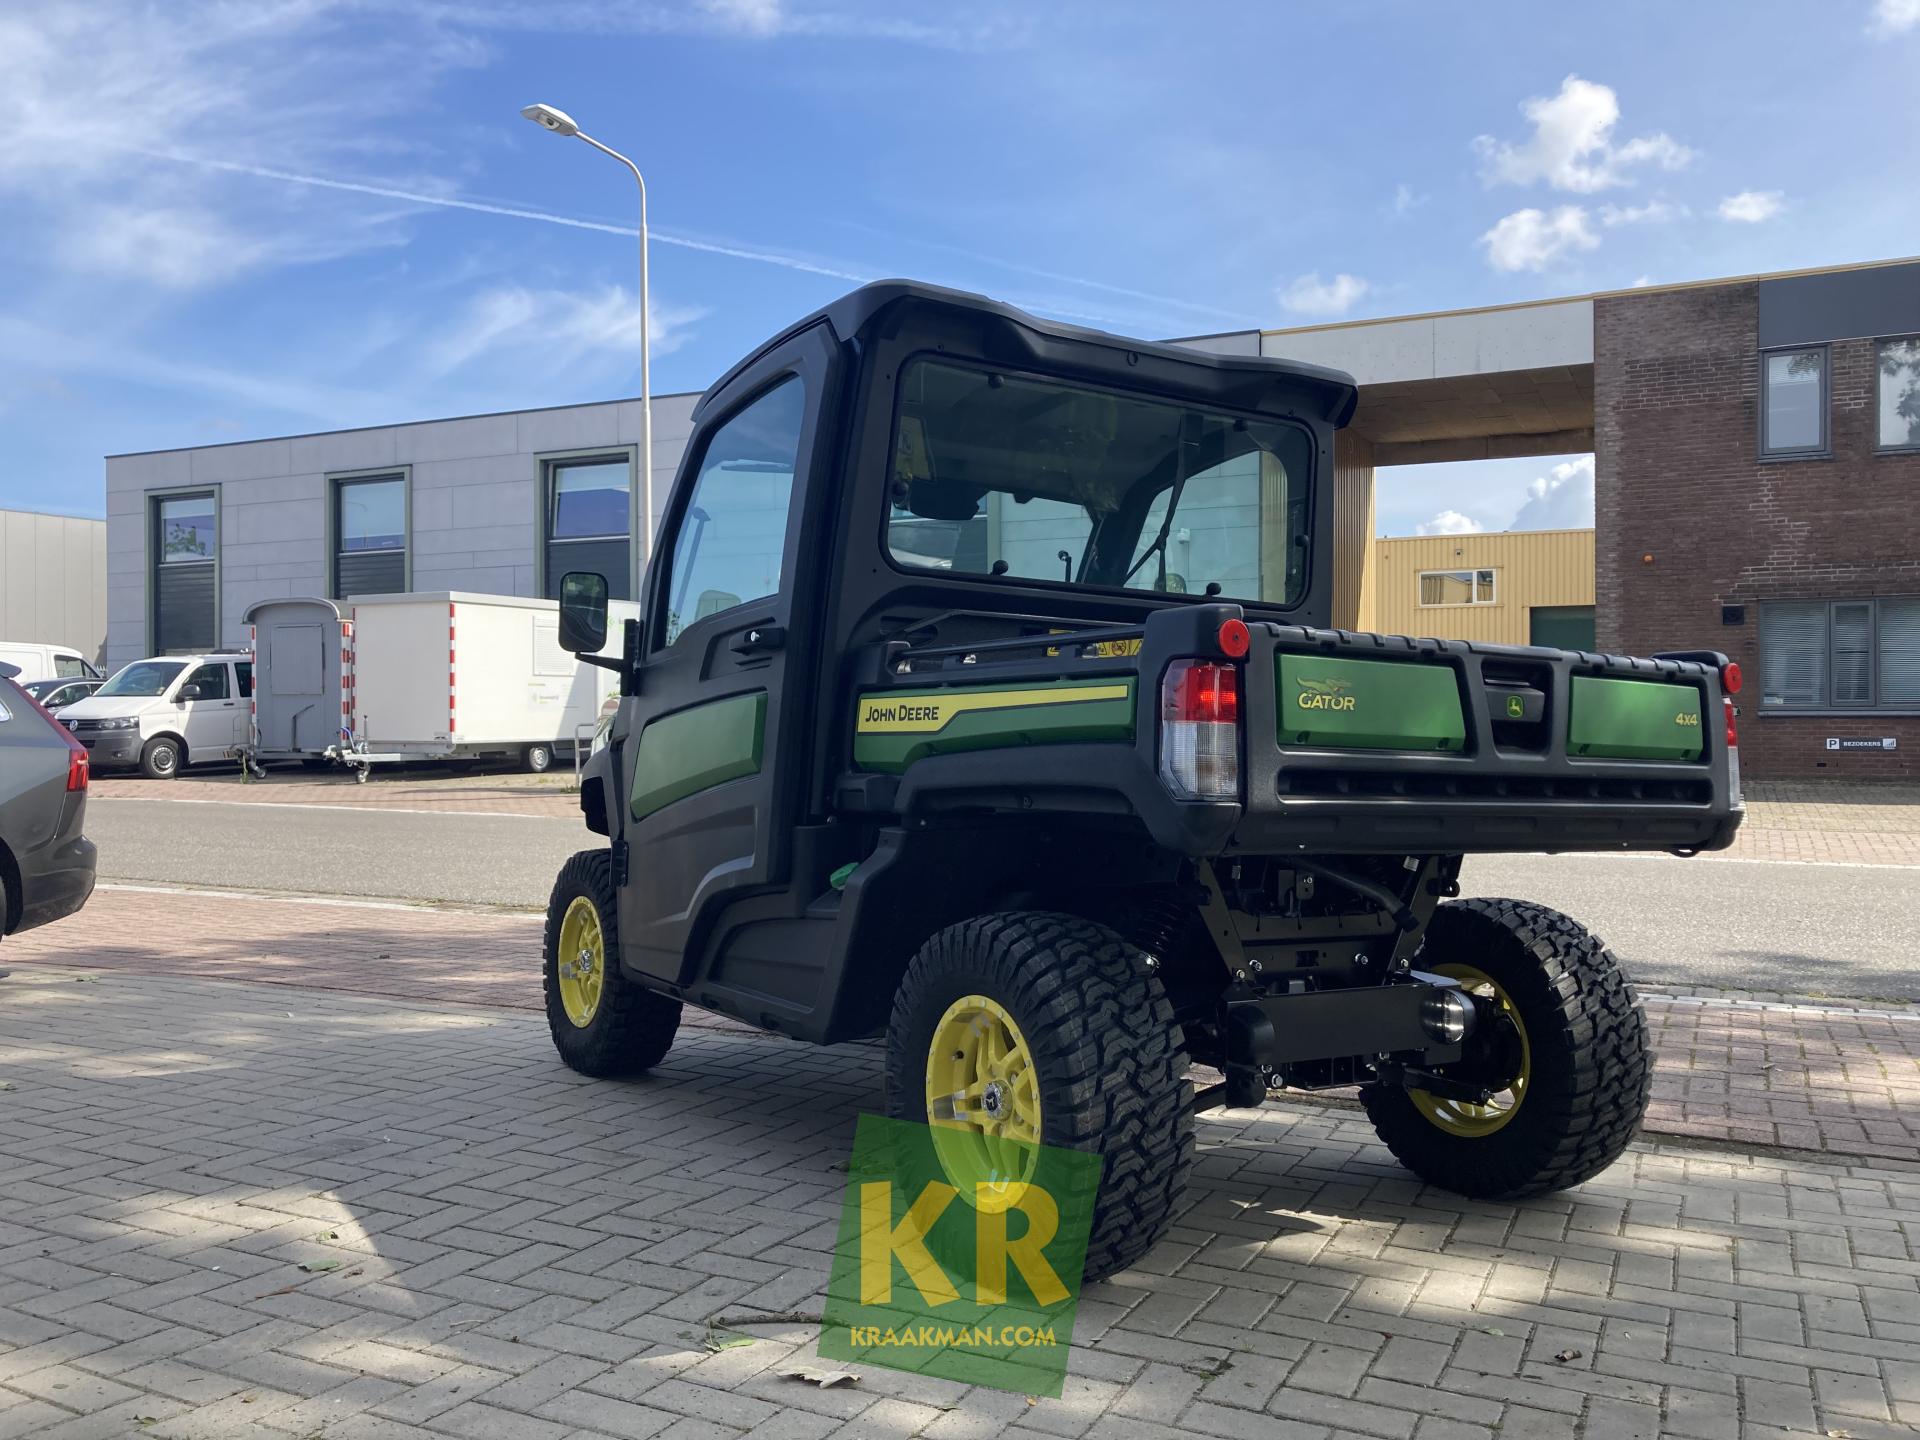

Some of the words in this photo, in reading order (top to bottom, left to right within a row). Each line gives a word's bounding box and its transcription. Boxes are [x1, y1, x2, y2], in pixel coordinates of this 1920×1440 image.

[1298, 692, 1356, 711] GATOR
[865, 706, 896, 722] JOHN
[898, 704, 940, 722] DEERE
